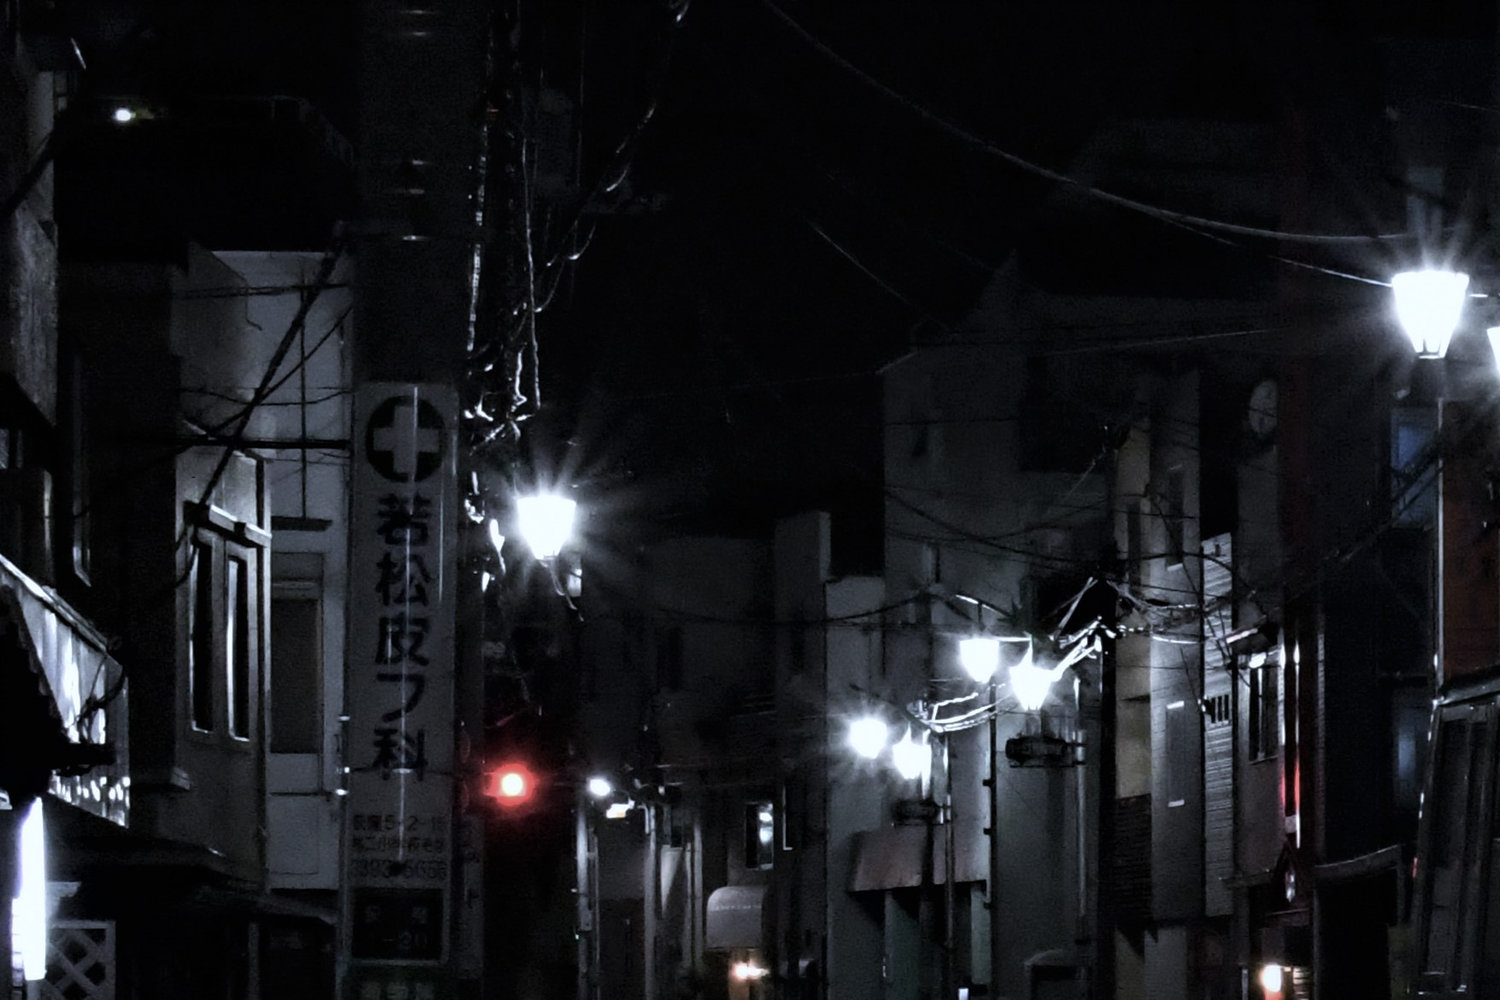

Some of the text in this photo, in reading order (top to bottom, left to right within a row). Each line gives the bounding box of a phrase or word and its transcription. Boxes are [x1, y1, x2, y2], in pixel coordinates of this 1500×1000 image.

[374, 494, 431, 781] 若松皮フ科
